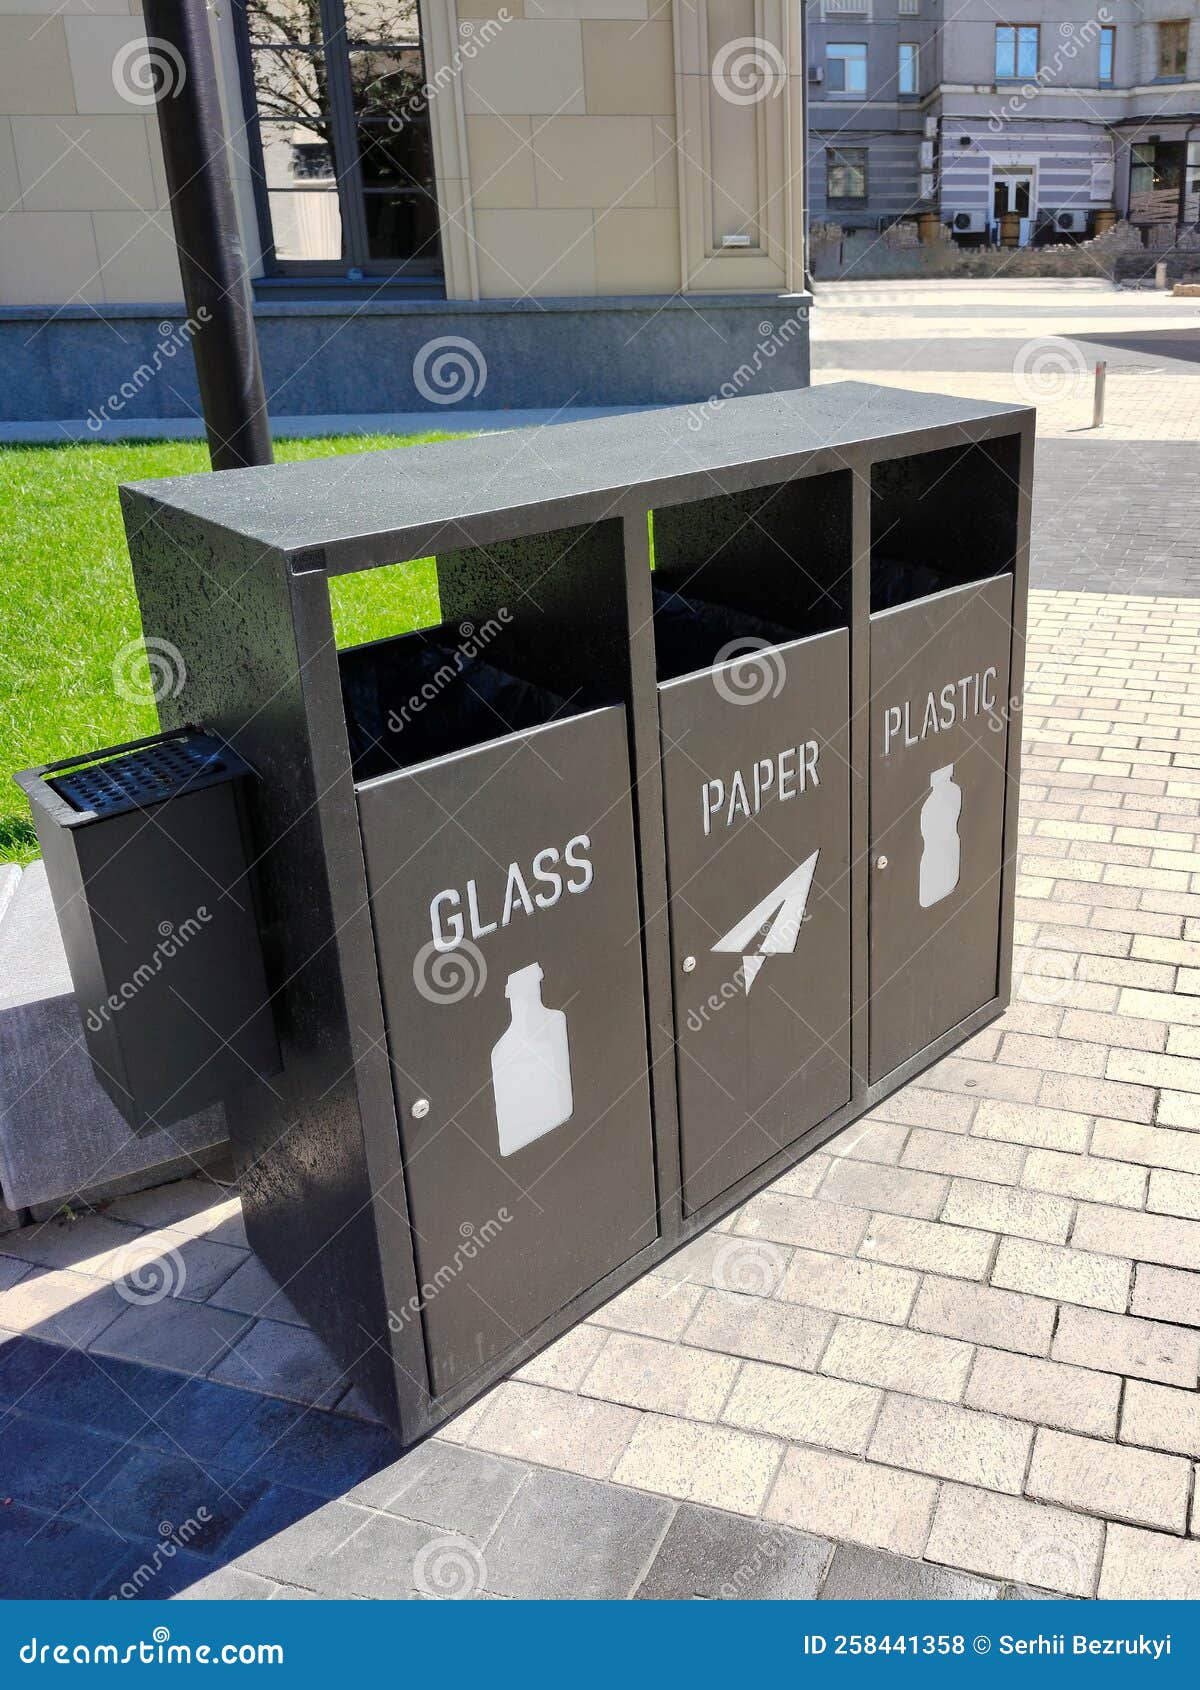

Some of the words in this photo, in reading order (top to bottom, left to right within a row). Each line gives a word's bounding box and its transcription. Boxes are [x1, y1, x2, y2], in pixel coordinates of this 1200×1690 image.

[885, 666, 998, 756] PLASTIC
[702, 740, 821, 836] PAPER
[430, 834, 594, 952] GLASS
